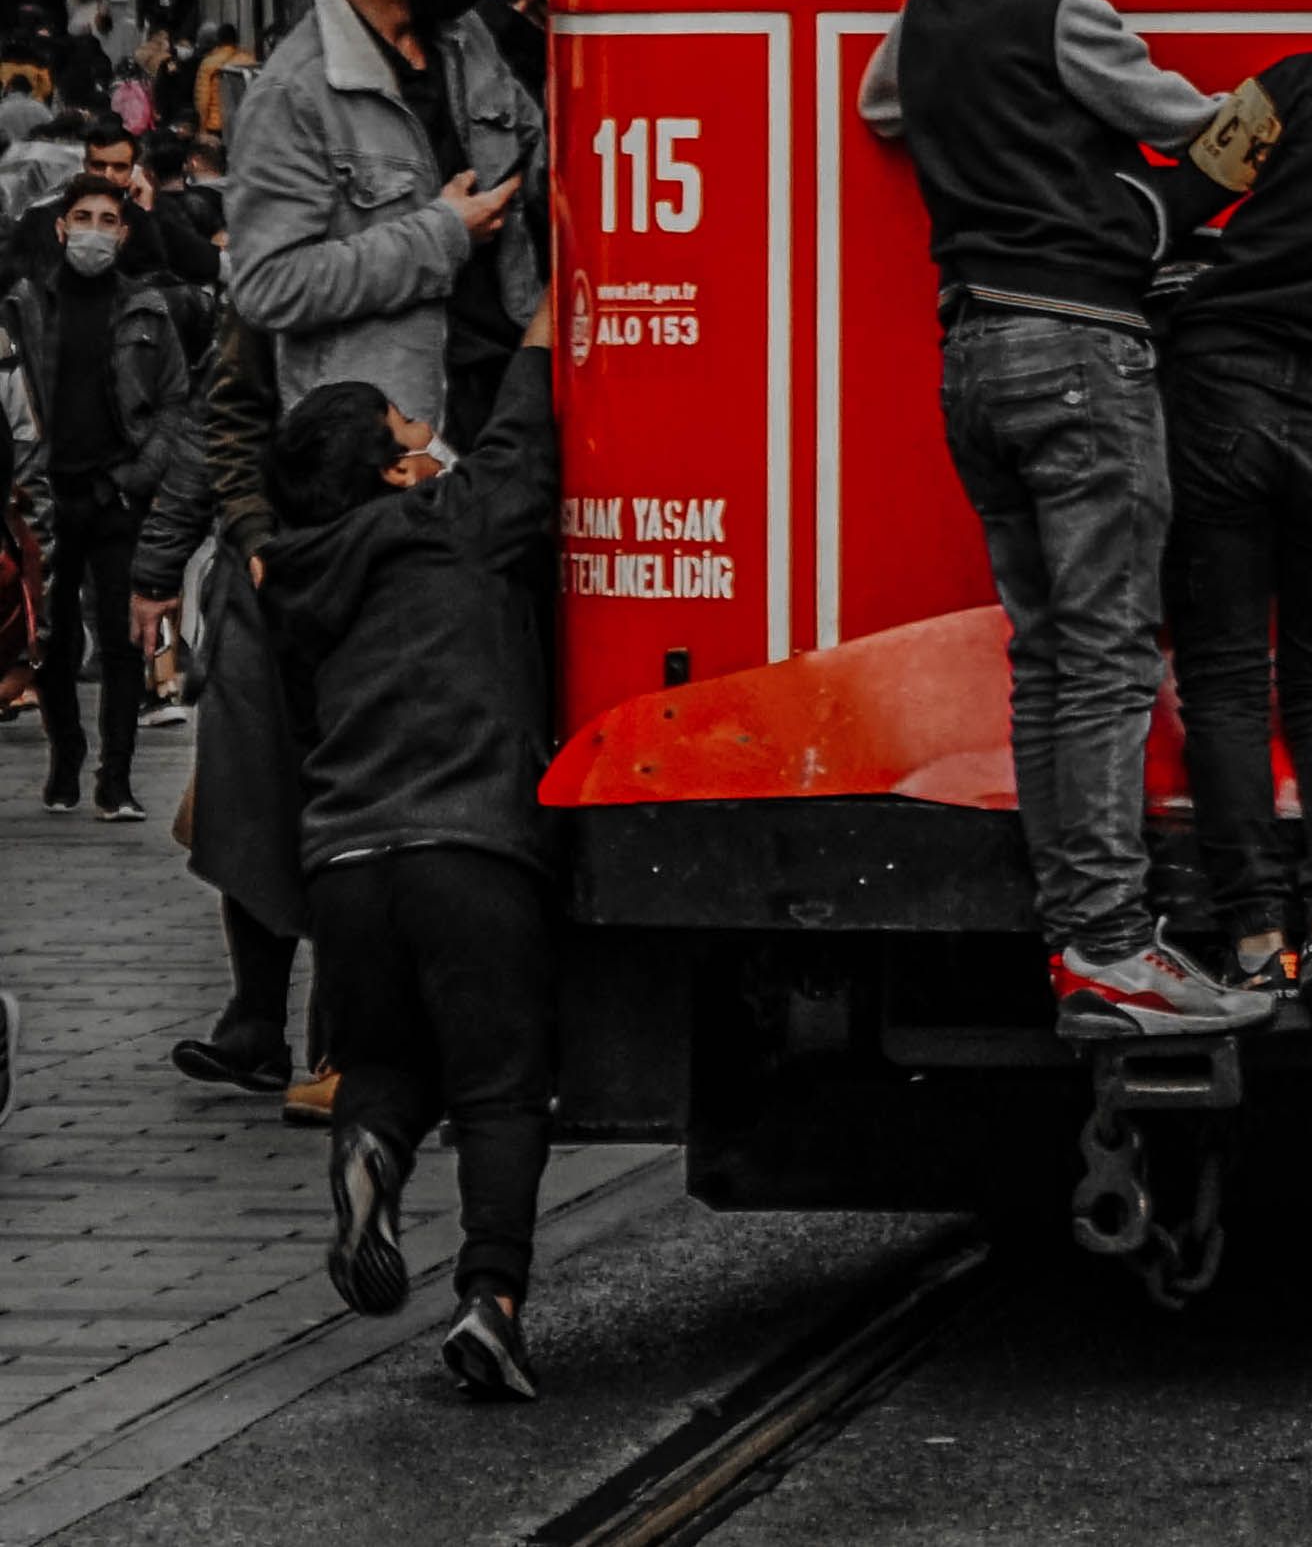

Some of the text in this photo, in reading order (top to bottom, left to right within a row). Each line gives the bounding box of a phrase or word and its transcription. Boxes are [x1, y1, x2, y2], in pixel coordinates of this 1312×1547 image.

[593, 117, 701, 234] 115
[595, 314, 642, 346] ALO
[647, 315, 700, 346] 153
[632, 497, 727, 543] YASAK
